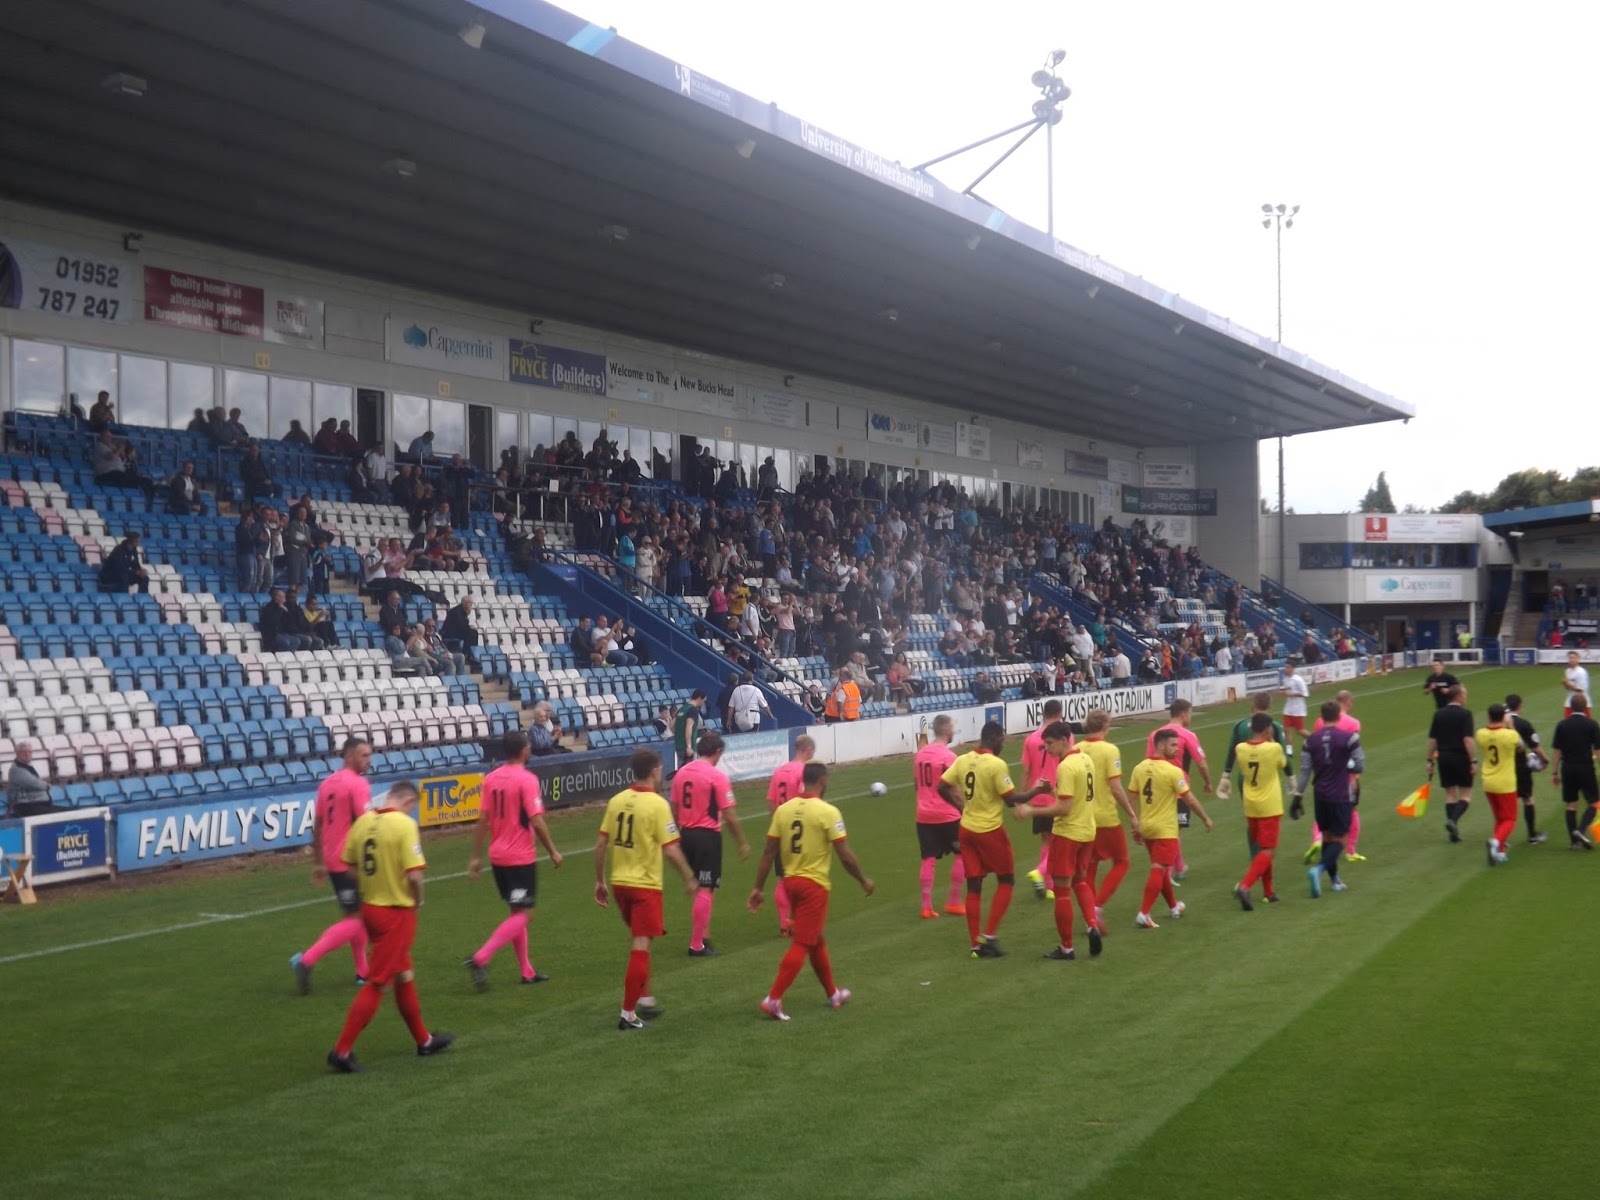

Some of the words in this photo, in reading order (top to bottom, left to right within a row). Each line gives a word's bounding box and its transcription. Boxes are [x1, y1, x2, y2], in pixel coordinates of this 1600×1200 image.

[800, 119, 853, 166] University
[855, 150, 864, 166] of
[866, 152, 934, 198] Wolverhampton
[56, 256, 119, 288] 01952
[170, 274, 201, 293] Quality
[203, 281, 231, 297] homes
[233, 288, 242, 298] at
[39, 287, 76, 313] 787
[83, 296, 119, 320] 247
[170, 293, 214, 311] affordable
[217, 304, 242, 317] prices
[150, 305, 202, 324] Throughout
[205, 317, 218, 327] the
[222, 318, 260, 335] Midlands
[428, 327, 492, 360] Capgemini
[511, 356, 548, 380] PRYCE
[552, 362, 605, 393] (Builders)
[609, 362, 643, 381] Welcome
[646, 372, 654, 382] to
[655, 371, 670, 386] The
[680, 376, 699, 390] New
[697, 379, 717, 394] Bucks
[717, 384, 734, 397] Head
[1140, 502, 1178, 511] SHOPPING
[1179, 502, 1209, 511] CENTRE
[1158, 492, 1190, 501] TELFORD
[1027, 701, 1044, 727] NE
[1061, 696, 1086, 722] UCKS
[1087, 693, 1112, 713] HEAD
[1114, 688, 1152, 713] STADIUM
[1488, 744, 1499, 766] 3
[919, 762, 932, 787] 10
[965, 771, 976, 800] 9
[1086, 772, 1094, 802] 8
[1249, 762, 1259, 787] 7
[423, 780, 459, 808] TTC
[492, 789, 504, 819] 11
[683, 781, 693, 809] 6
[1143, 777, 1153, 804] 4
[57, 833, 89, 849] PRYCE
[138, 806, 257, 858] FAMILY
[263, 799, 317, 842] STA
[614, 811, 635, 848] 11
[791, 819, 803, 855] 2
[56, 848, 90, 862] (Builders)
[63, 859, 83, 867] Limited
[364, 838, 376, 876] 6
